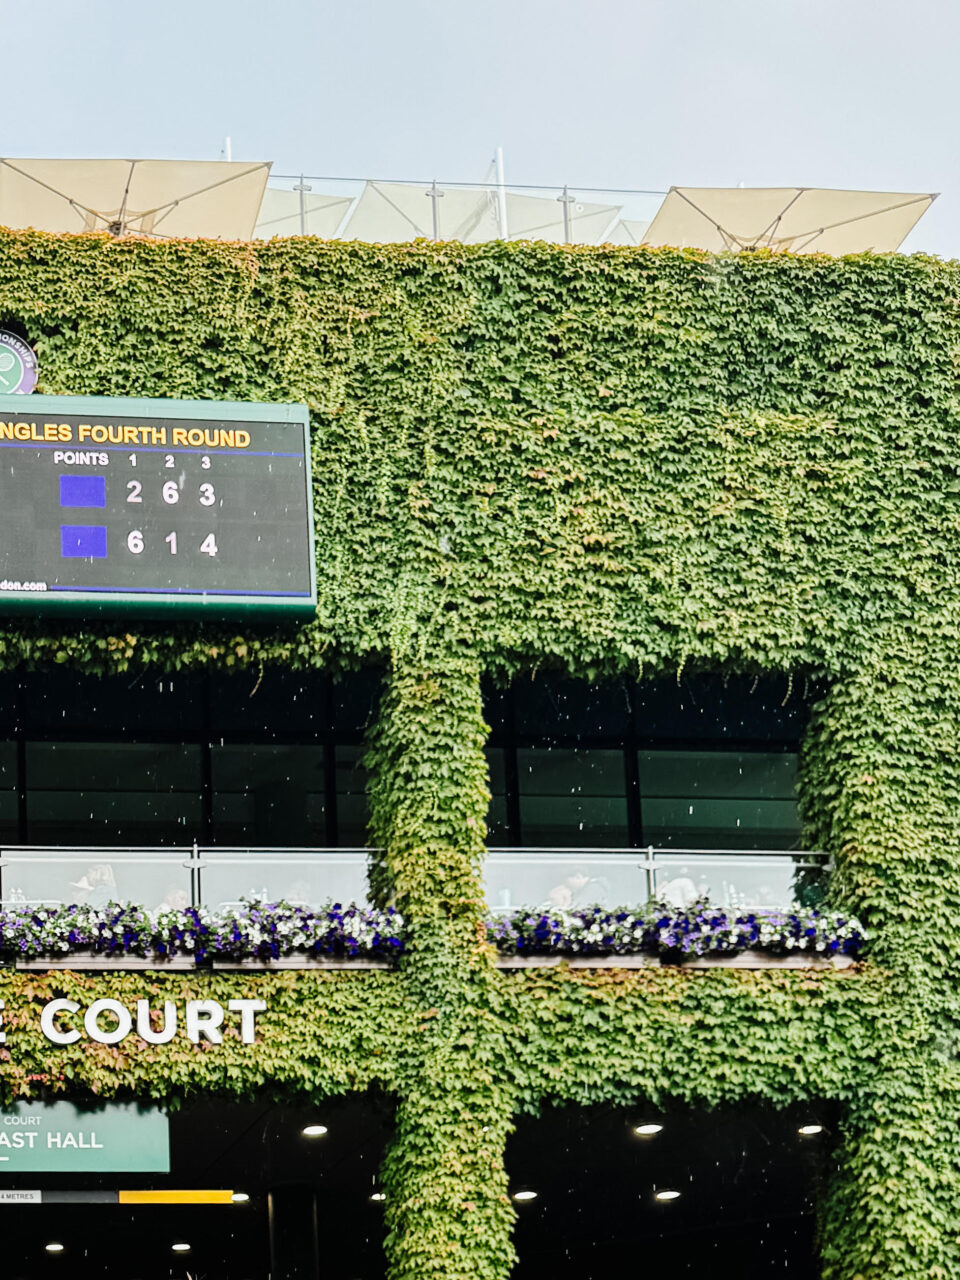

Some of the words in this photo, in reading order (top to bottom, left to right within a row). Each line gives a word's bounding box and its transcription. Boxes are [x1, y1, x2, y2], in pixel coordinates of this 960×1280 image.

[78, 425, 167, 444] FOURTH
[172, 428, 251, 448] ROUND
[53, 451, 109, 466] POINTS
[128, 454, 137, 466] 1
[164, 455, 175, 468] 2
[201, 456, 211, 469] 3
[126, 480, 142, 503] 2
[162, 481, 179, 504] 6
[199, 483, 216, 506] 3
[127, 530, 144, 554] 6
[165, 532, 177, 554] 1
[200, 533, 218, 556] 4
[40, 998, 267, 1045] COURT
[4, 1116, 42, 1125] COURT
[47, 1132, 104, 1149] HALL
